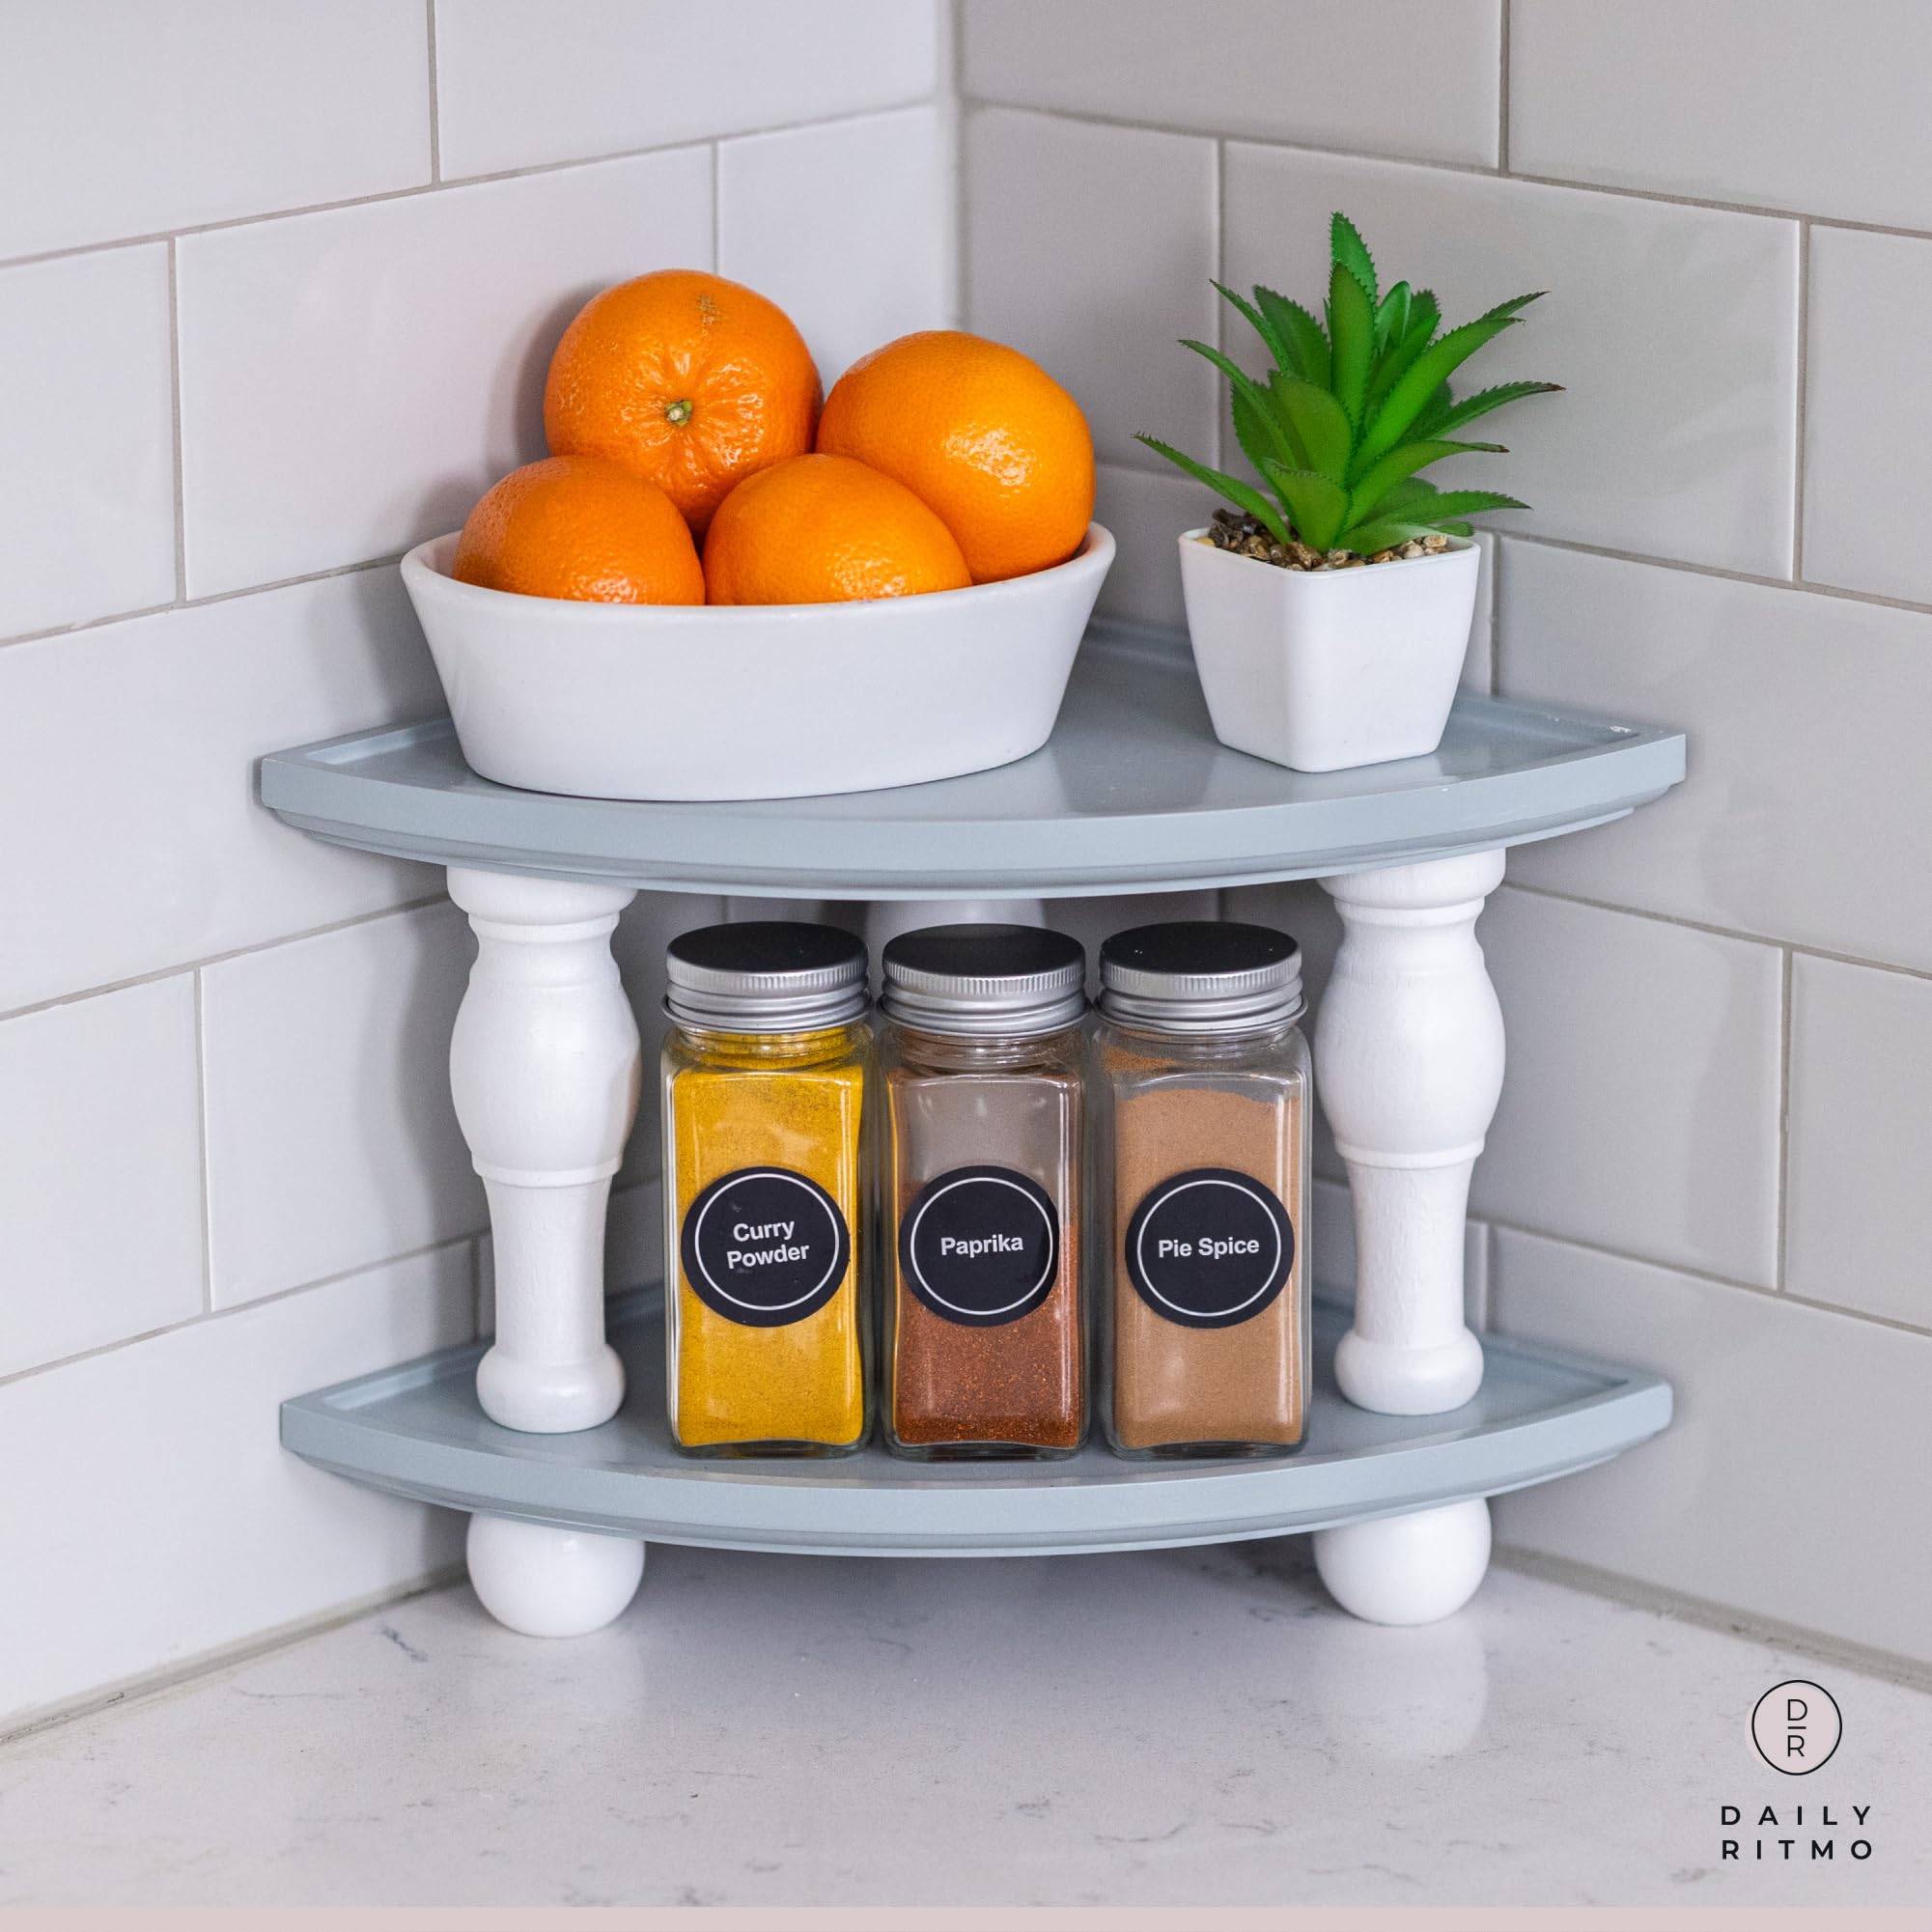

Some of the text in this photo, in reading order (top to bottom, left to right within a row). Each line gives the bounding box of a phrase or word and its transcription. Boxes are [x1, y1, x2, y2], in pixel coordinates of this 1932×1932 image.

[733, 1218, 796, 1243] Curry
[726, 1241, 810, 1270] Powder
[940, 1233, 1024, 1259] Paprika
[1158, 1235, 1260, 1261] Pie Spice
